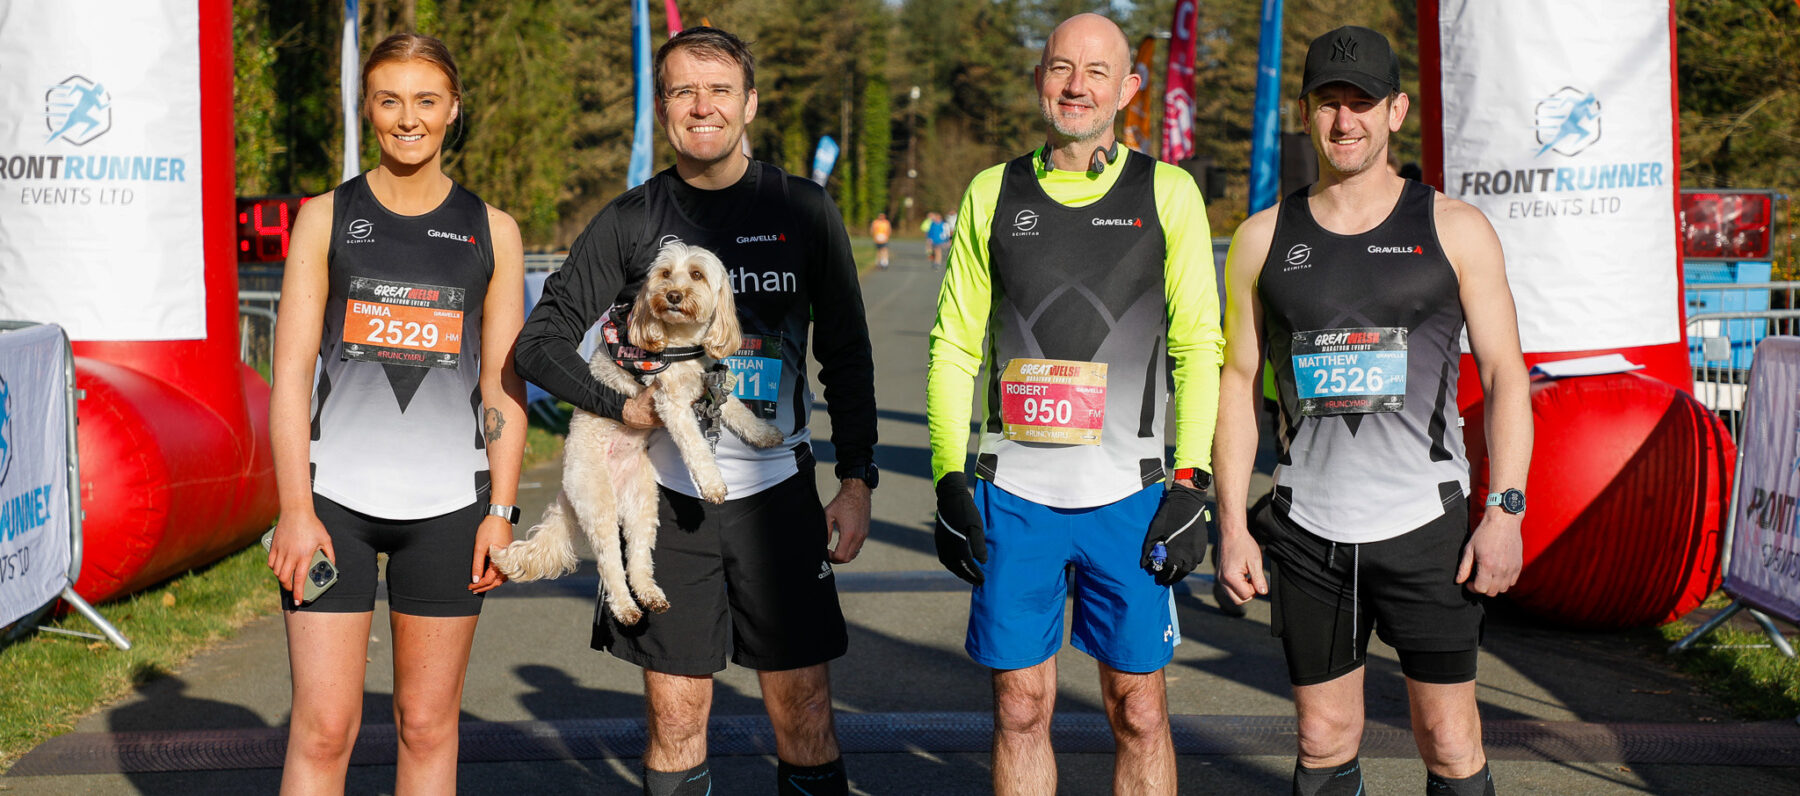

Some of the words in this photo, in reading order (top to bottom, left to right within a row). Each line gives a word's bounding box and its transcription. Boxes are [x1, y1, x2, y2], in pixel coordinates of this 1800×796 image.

[0, 154, 187, 182] RONTRUNNER
[1459, 162, 1664, 197] FRONTRUNNER
[20, 186, 92, 205] EVENTS
[99, 187, 135, 206] LTD
[1509, 199, 1584, 219] EVENTS
[1590, 197, 1622, 215] LTD
[728, 266, 797, 295] than
[352, 302, 392, 317] EMMA
[366, 318, 440, 349] 2529
[445, 333, 459, 342] HM
[377, 350, 426, 362] #RUNCYMRU
[723, 358, 764, 371] ATHAN
[1298, 354, 1359, 369] MATTHEW
[735, 371, 760, 397] 11
[1313, 366, 1384, 395] 2526
[1390, 374, 1404, 383] HM
[1006, 383, 1049, 396] ROBERT
[1023, 398, 1073, 425] 950
[1324, 399, 1373, 409] #RUNCYMRU
[1088, 409, 1102, 418] FM
